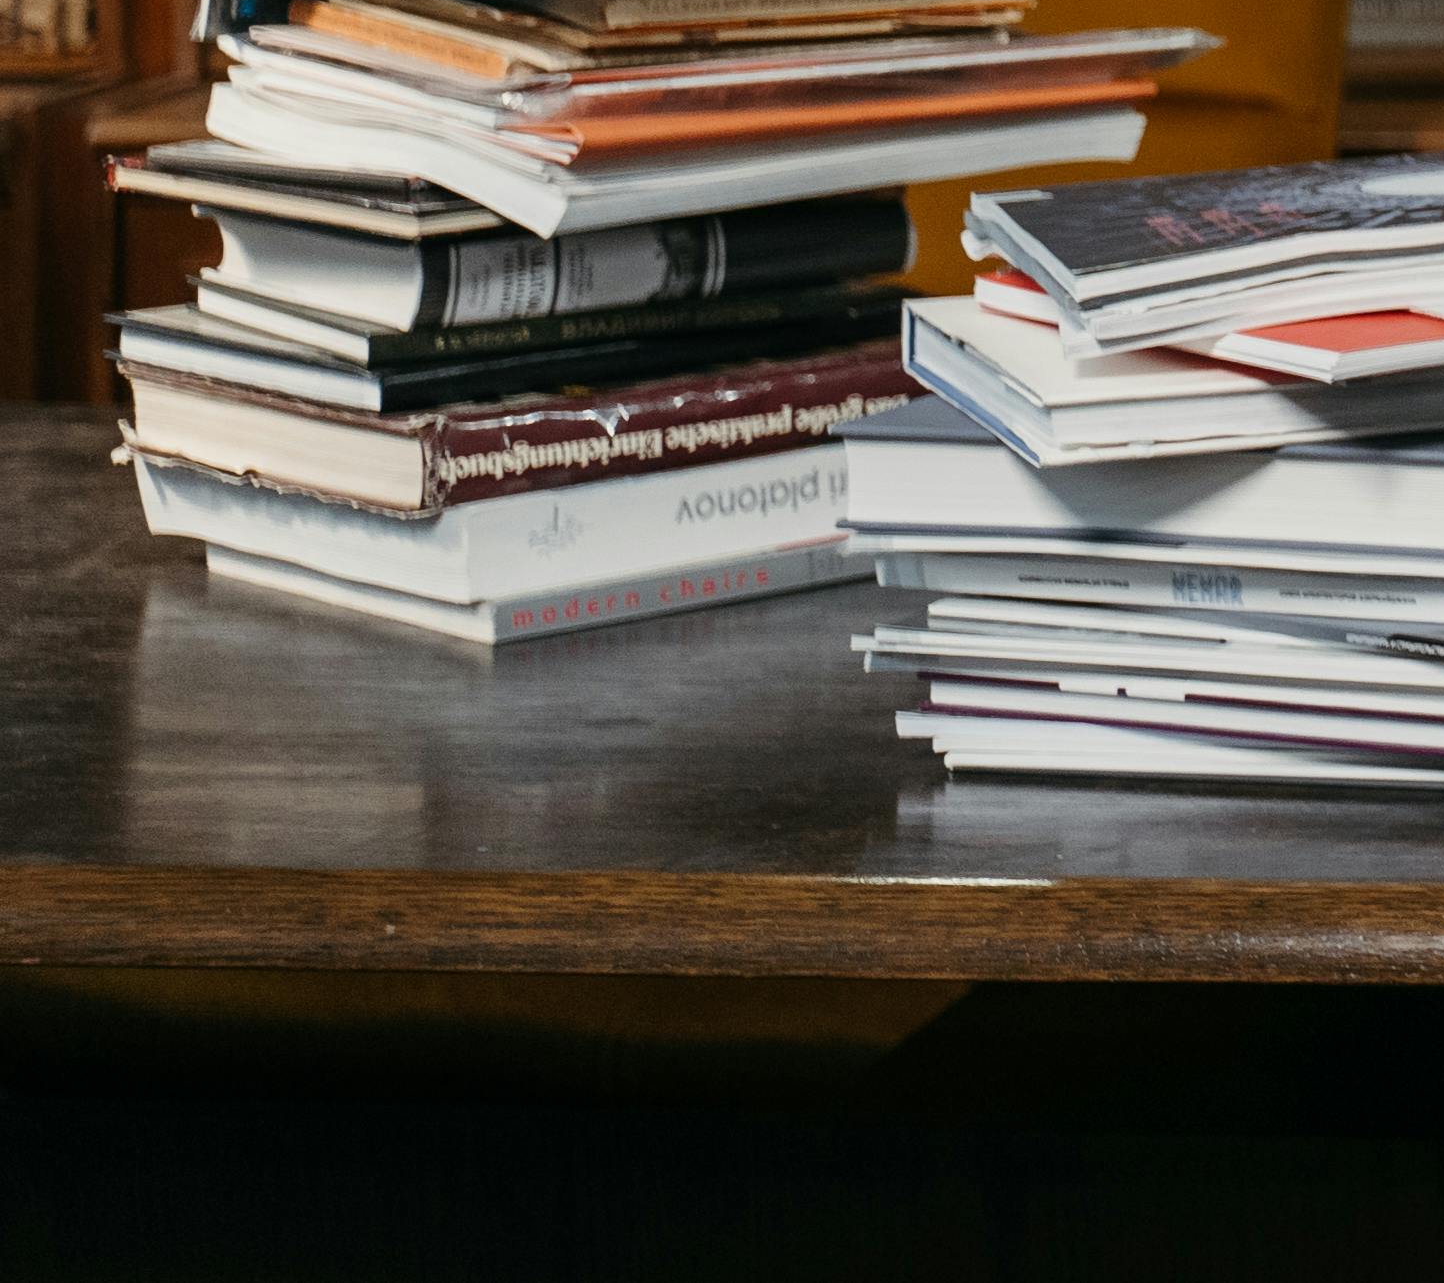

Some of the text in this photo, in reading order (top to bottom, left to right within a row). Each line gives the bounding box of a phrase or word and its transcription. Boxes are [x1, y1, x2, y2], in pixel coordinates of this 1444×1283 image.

[438, 429, 663, 486] Einrichtungsbuch
[664, 403, 794, 454] praktische
[675, 464, 820, 525] platonov
[512, 590, 641, 629] modern
[659, 566, 770, 605] chairs
